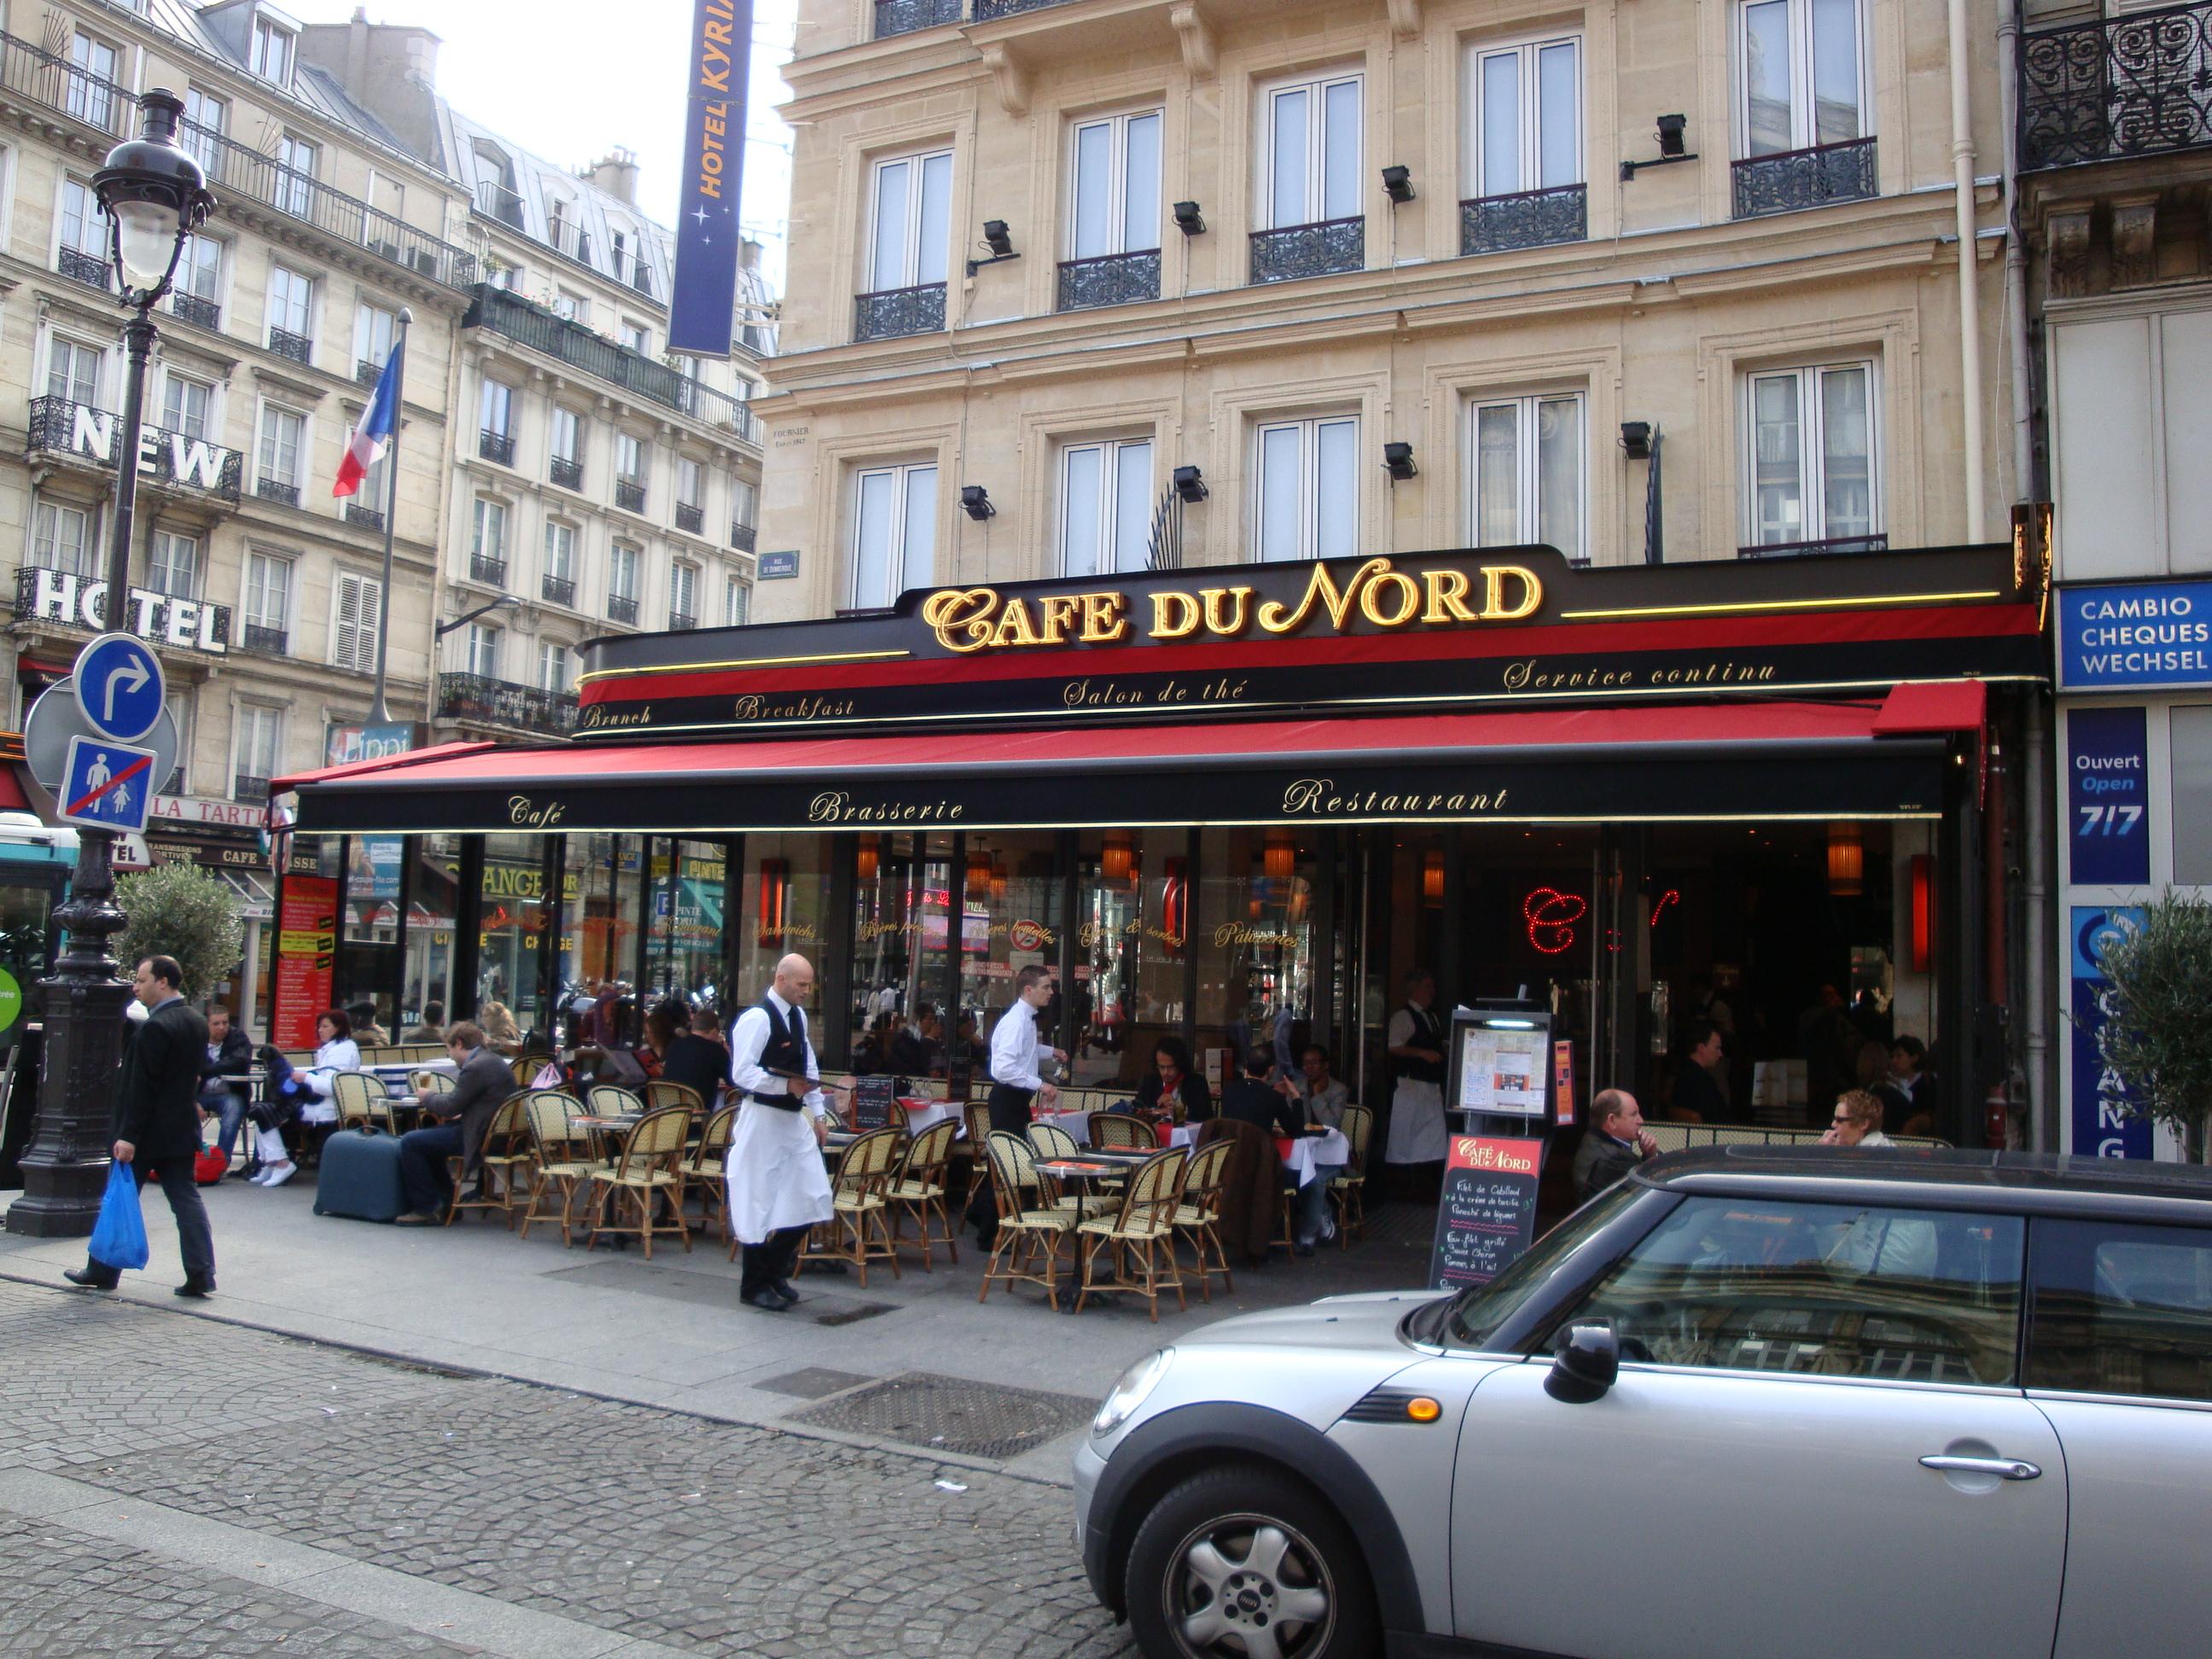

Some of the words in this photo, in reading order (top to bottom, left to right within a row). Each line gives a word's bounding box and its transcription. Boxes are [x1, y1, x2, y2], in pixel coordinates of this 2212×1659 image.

[700, 101, 726, 199] HOTEL
[72, 405, 227, 489] NEW
[922, 587, 1128, 654] CAFE
[1148, 587, 1256, 636] DU
[1258, 556, 1545, 634] NORD
[2081, 597, 2192, 620] CAMBIO
[2081, 623, 2209, 647] CHEQUES
[2081, 650, 2209, 673] WECHSEL
[583, 704, 652, 728] Brunch
[735, 695, 854, 719] Breakfast
[1063, 678, 1144, 710] Salon
[1158, 681, 1187, 701] de
[1202, 677, 1249, 701] thé
[1504, 660, 1633, 694] Service
[1651, 663, 1776, 683] continu
[2075, 754, 2140, 770] Ouvert
[2082, 777, 2134, 795] Open
[153, 797, 183, 818] LA
[508, 795, 566, 829] Café
[808, 791, 963, 822] Brasserie
[1282, 778, 1508, 813] Restaurant
[2078, 805, 2142, 836] 7/7
[1470, 1156, 1486, 1167] DU
[1486, 1150, 1531, 1170] NORD
